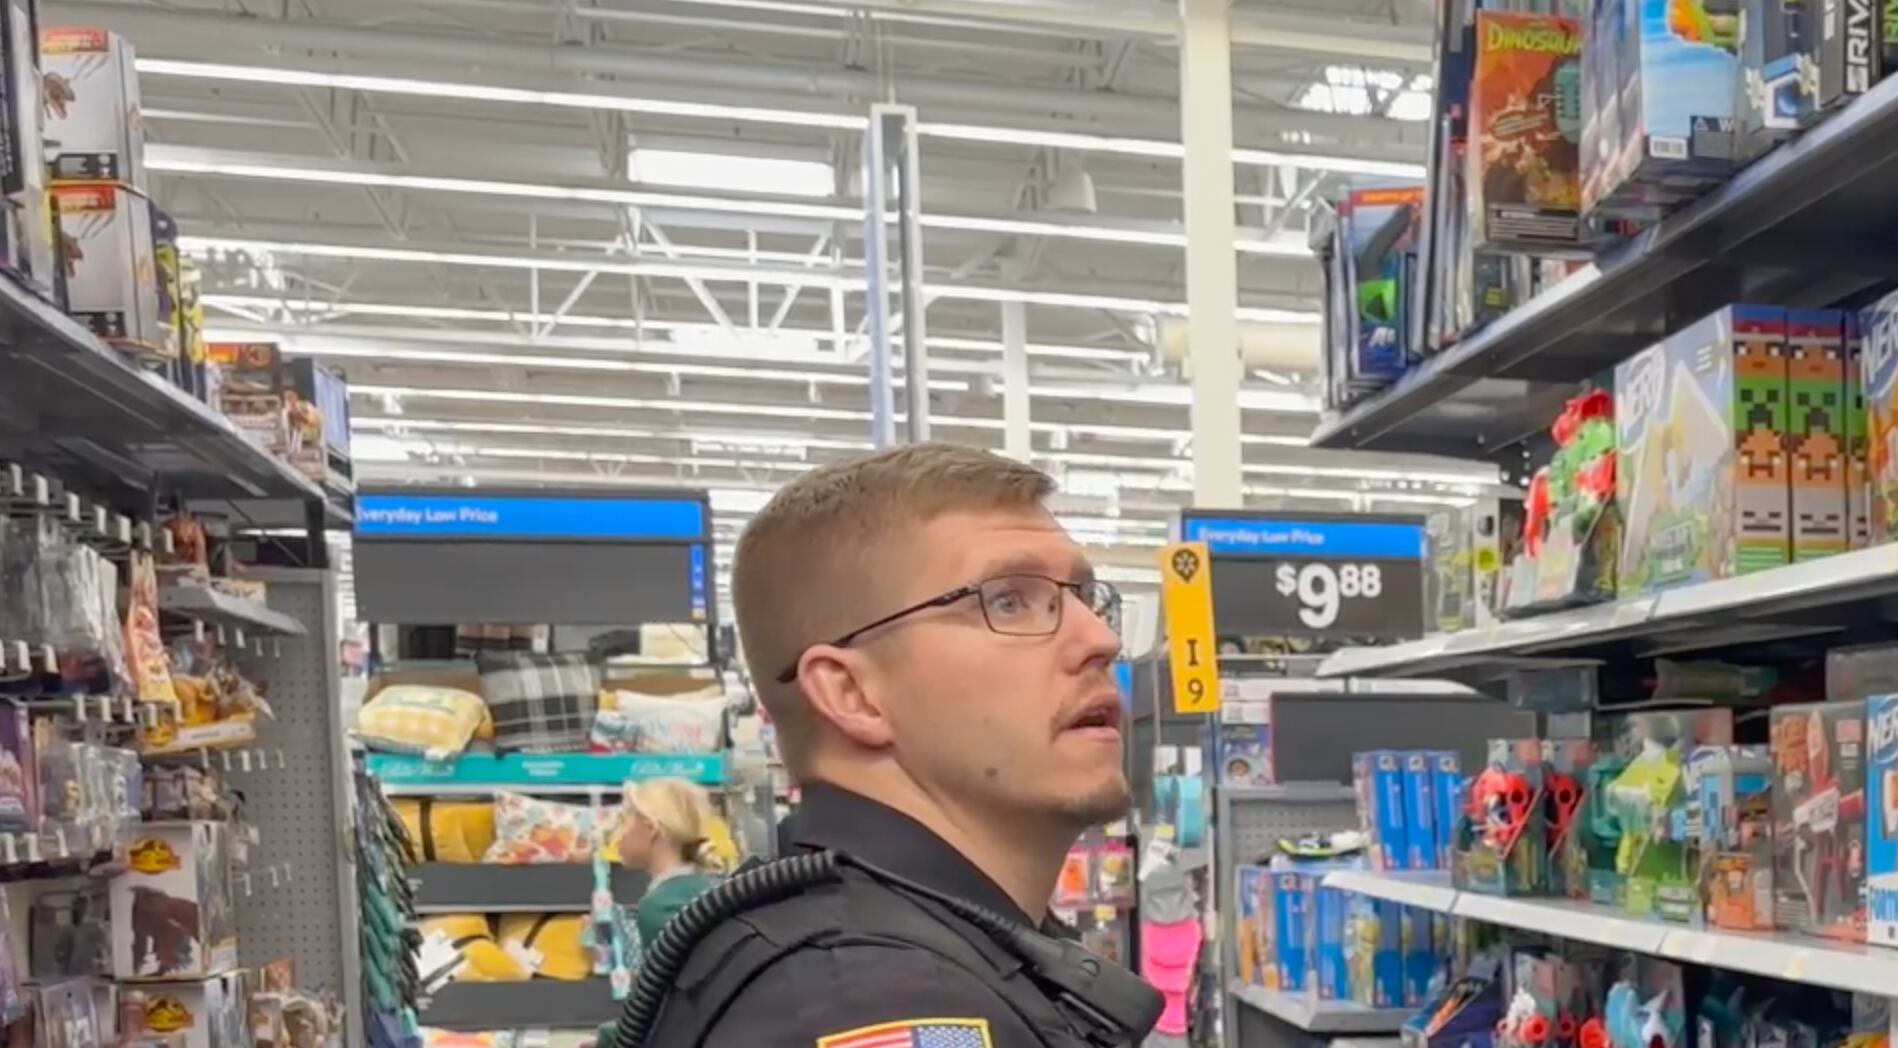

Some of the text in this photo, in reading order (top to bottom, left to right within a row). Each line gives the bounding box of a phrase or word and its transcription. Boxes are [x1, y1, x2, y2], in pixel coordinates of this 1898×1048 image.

[425, 508, 457, 522] Low
[459, 507, 498, 523] Price
[1188, 679, 1204, 704] 9
